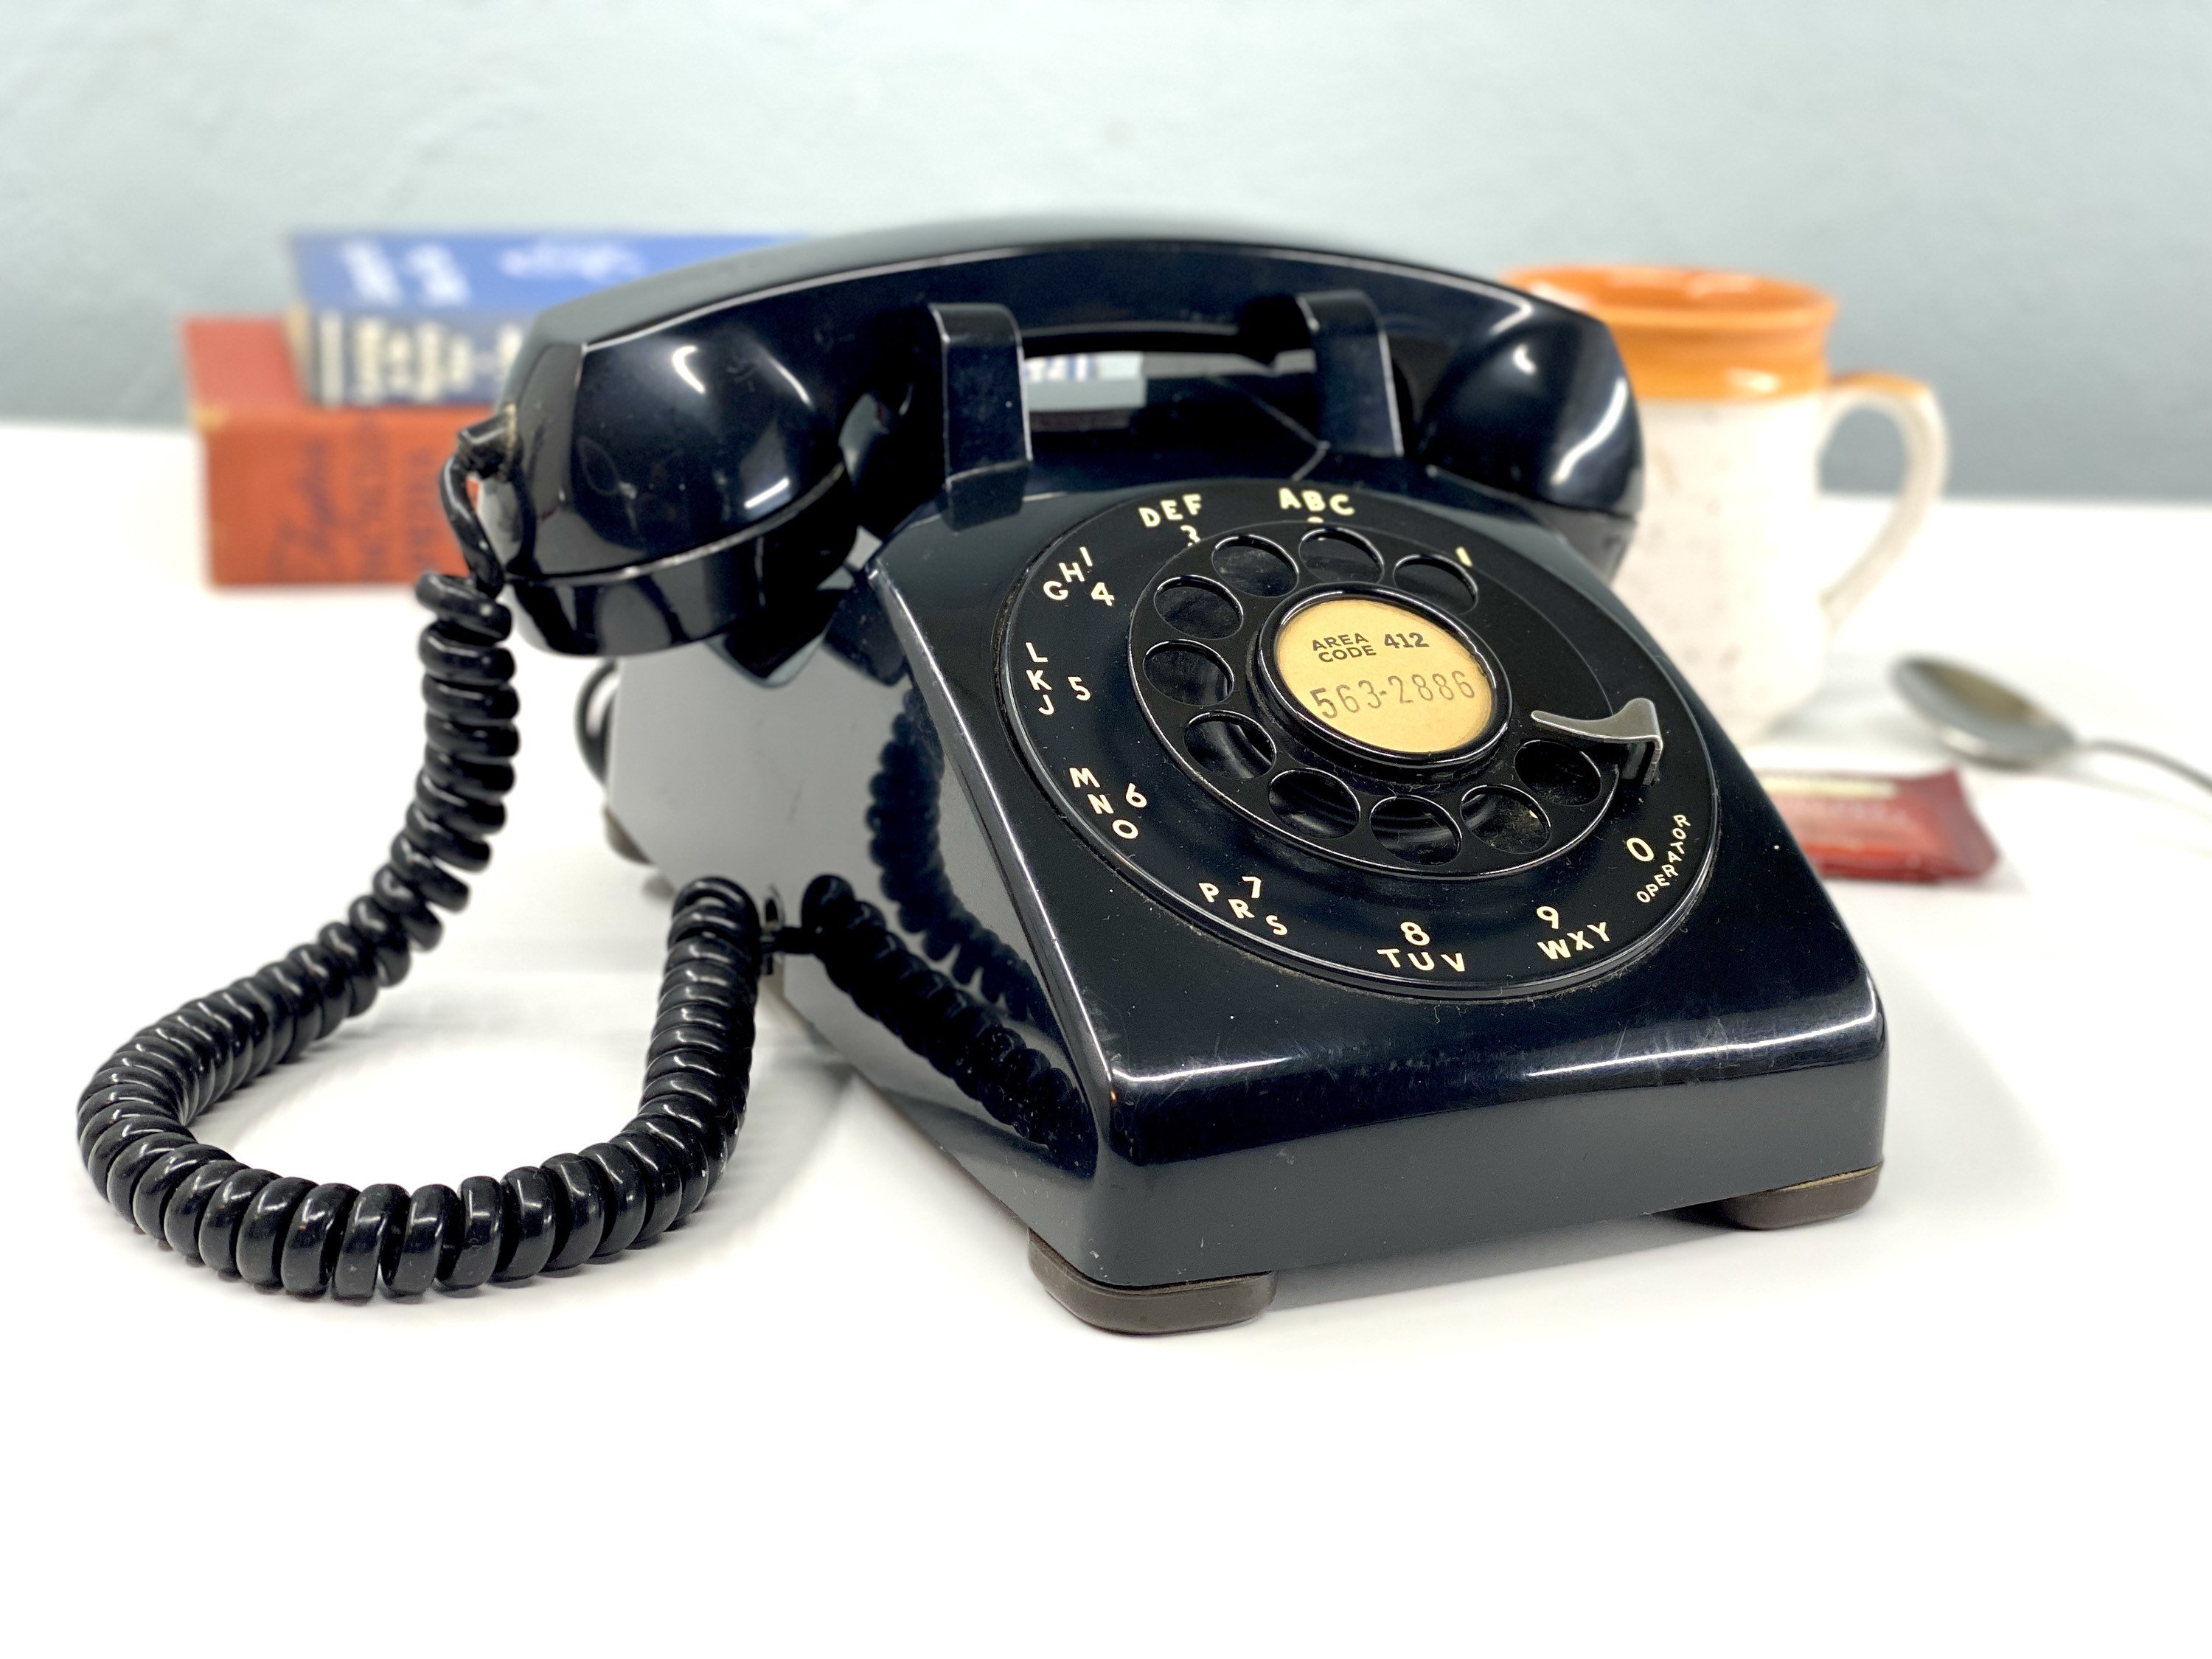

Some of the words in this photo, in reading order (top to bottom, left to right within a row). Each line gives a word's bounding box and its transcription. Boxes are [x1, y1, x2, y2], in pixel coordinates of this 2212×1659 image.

[1138, 493, 1202, 528] DEF
[1279, 487, 1355, 516] ABC
[1043, 546, 1093, 601] GHI
[1091, 582, 1116, 607] 4
[1312, 633, 1369, 651] AREA
[1318, 644, 1377, 663] CODE
[1384, 632, 1430, 649] 412
[1068, 676, 1091, 701] 5
[1310, 670, 1475, 719] 563-2886
[1069, 767, 1139, 839] MNO
[1125, 782, 1147, 808] 6
[1636, 814, 1691, 903] OPERATOR
[1242, 876, 1262, 899] 7
[1198, 883, 1288, 936] PRS
[1536, 905, 1559, 930] 9
[1400, 921, 1430, 946] 8
[1537, 921, 1610, 960] WXY
[1376, 948, 1466, 973] TUV
